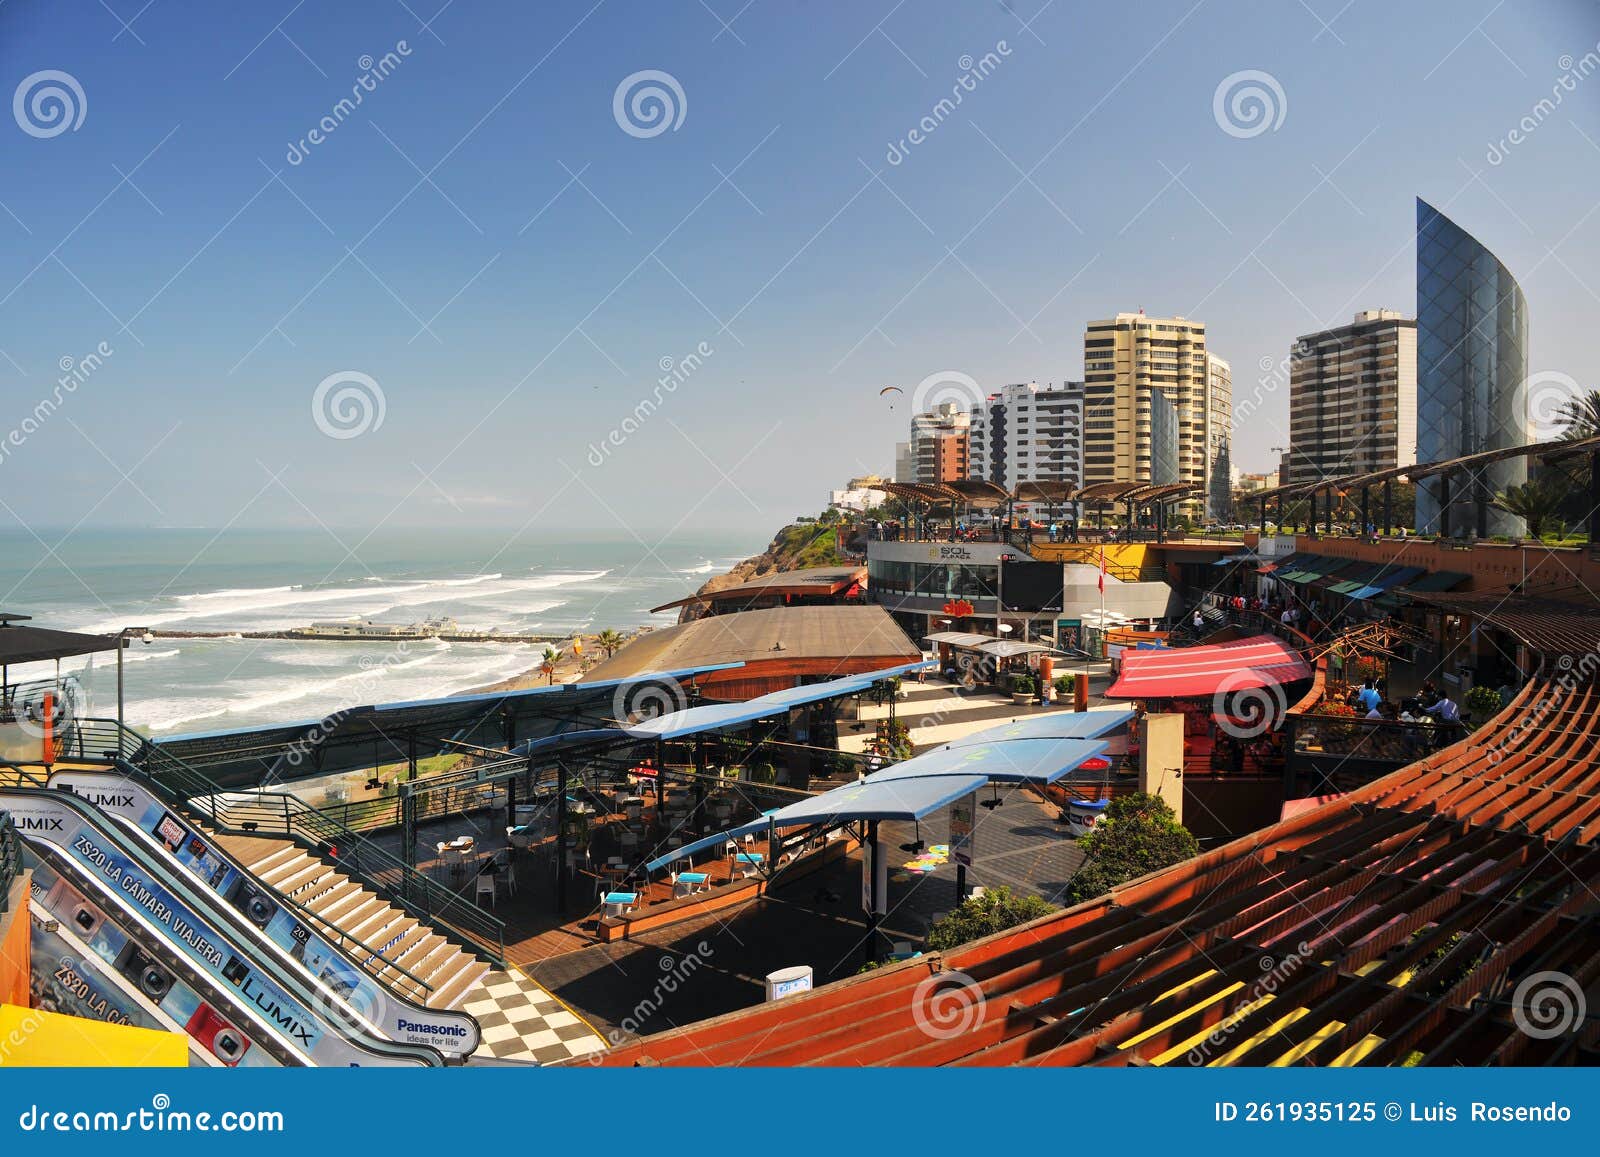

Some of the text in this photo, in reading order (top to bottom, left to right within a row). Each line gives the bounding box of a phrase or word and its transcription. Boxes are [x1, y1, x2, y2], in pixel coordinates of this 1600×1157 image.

[941, 547, 971, 555] SOL
[75, 790, 135, 807] UMIX
[12, 817, 63, 831] UMIX
[75, 835, 223, 968] ZS20 LA CÁMARA VIAJERA
[54, 965, 89, 999] ZS20
[88, 993, 108, 1016] LA
[242, 977, 314, 1047] LUMIX
[397, 1019, 467, 1037] Panasonic
[407, 1034, 459, 1047] ideas for life
